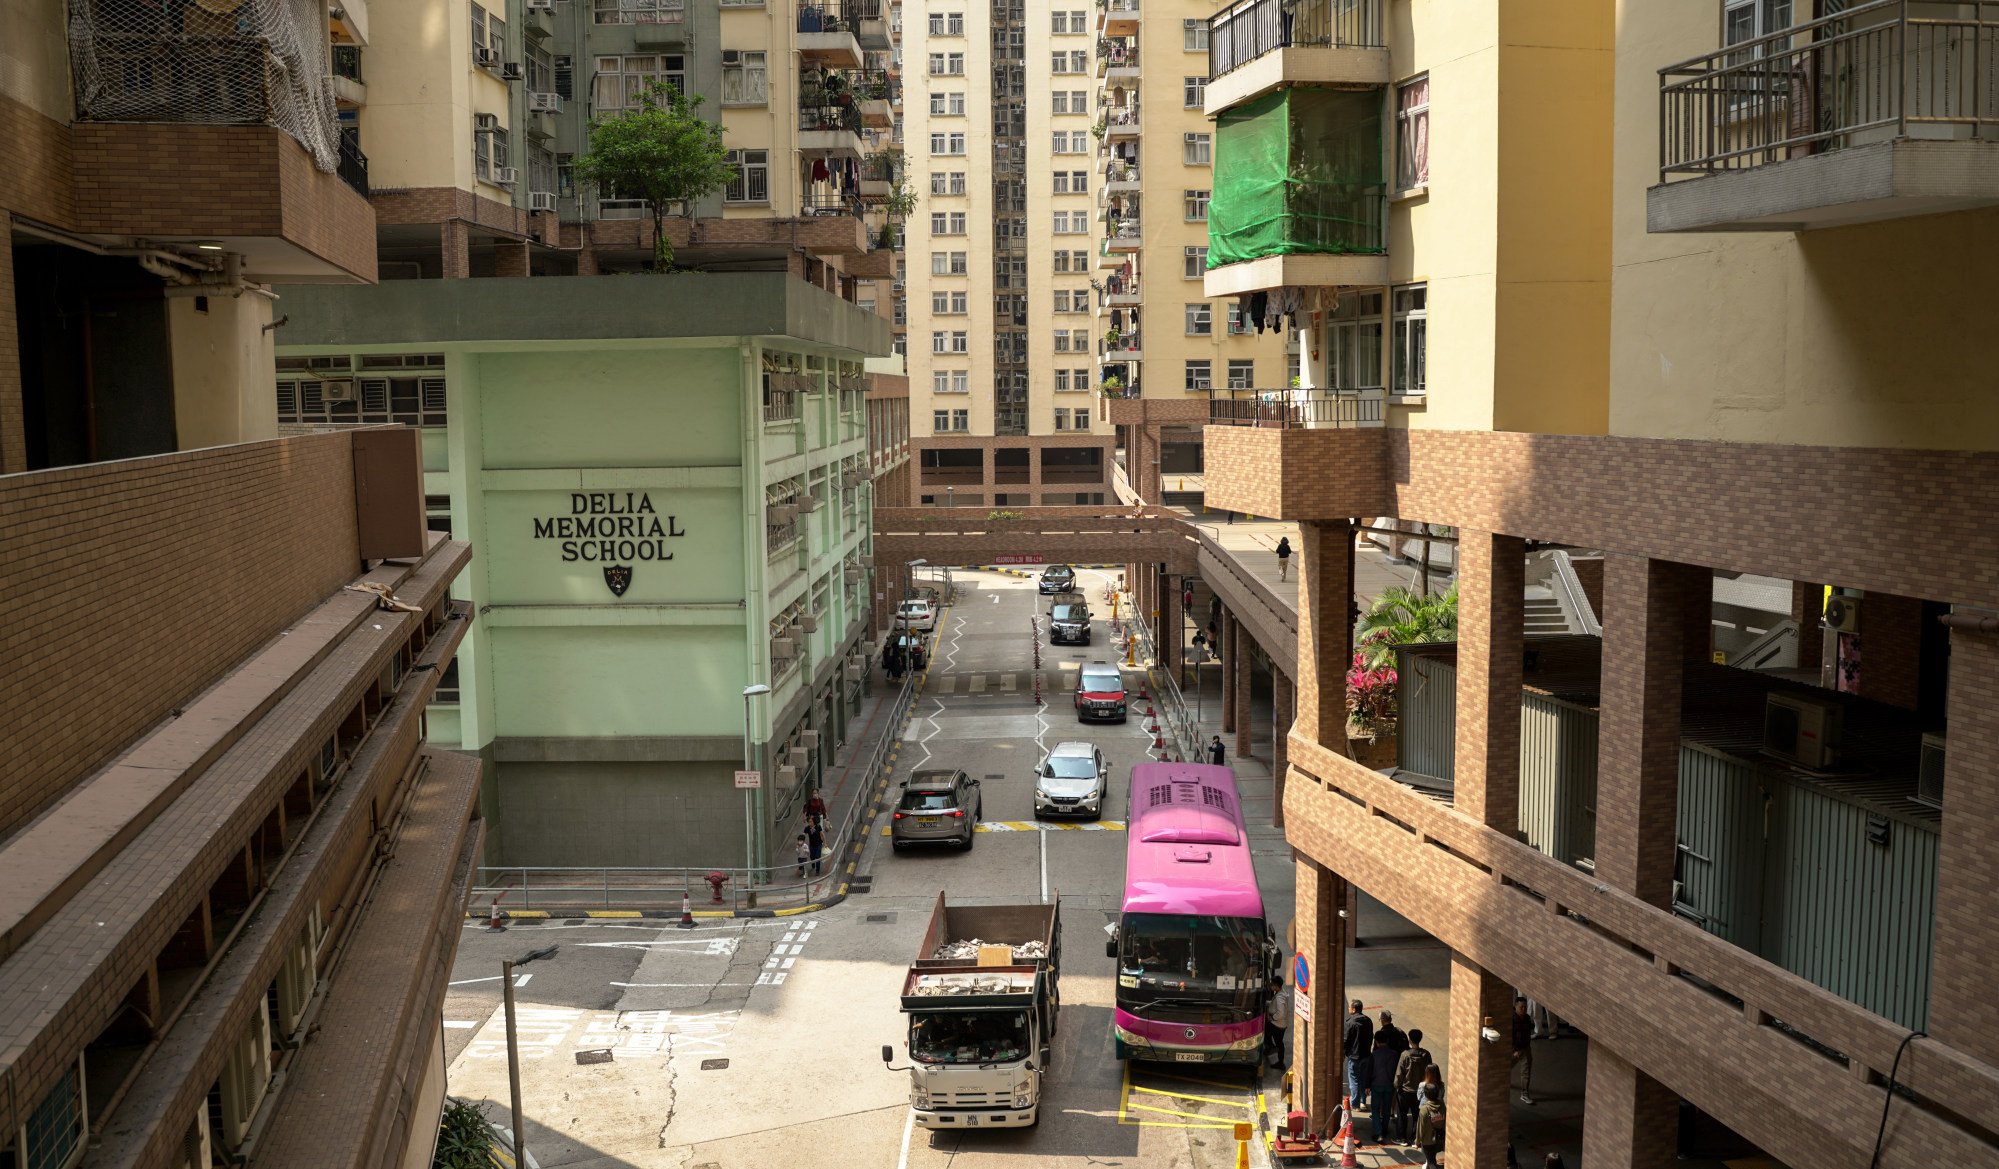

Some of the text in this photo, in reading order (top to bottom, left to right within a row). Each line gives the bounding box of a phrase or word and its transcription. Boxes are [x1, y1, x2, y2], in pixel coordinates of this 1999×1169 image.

[571, 492, 656, 514] DELIA
[533, 516, 685, 538] MEMORIAL
[562, 540, 673, 562] SCHOOL
[466, 1008, 585, 1059] SLOW
